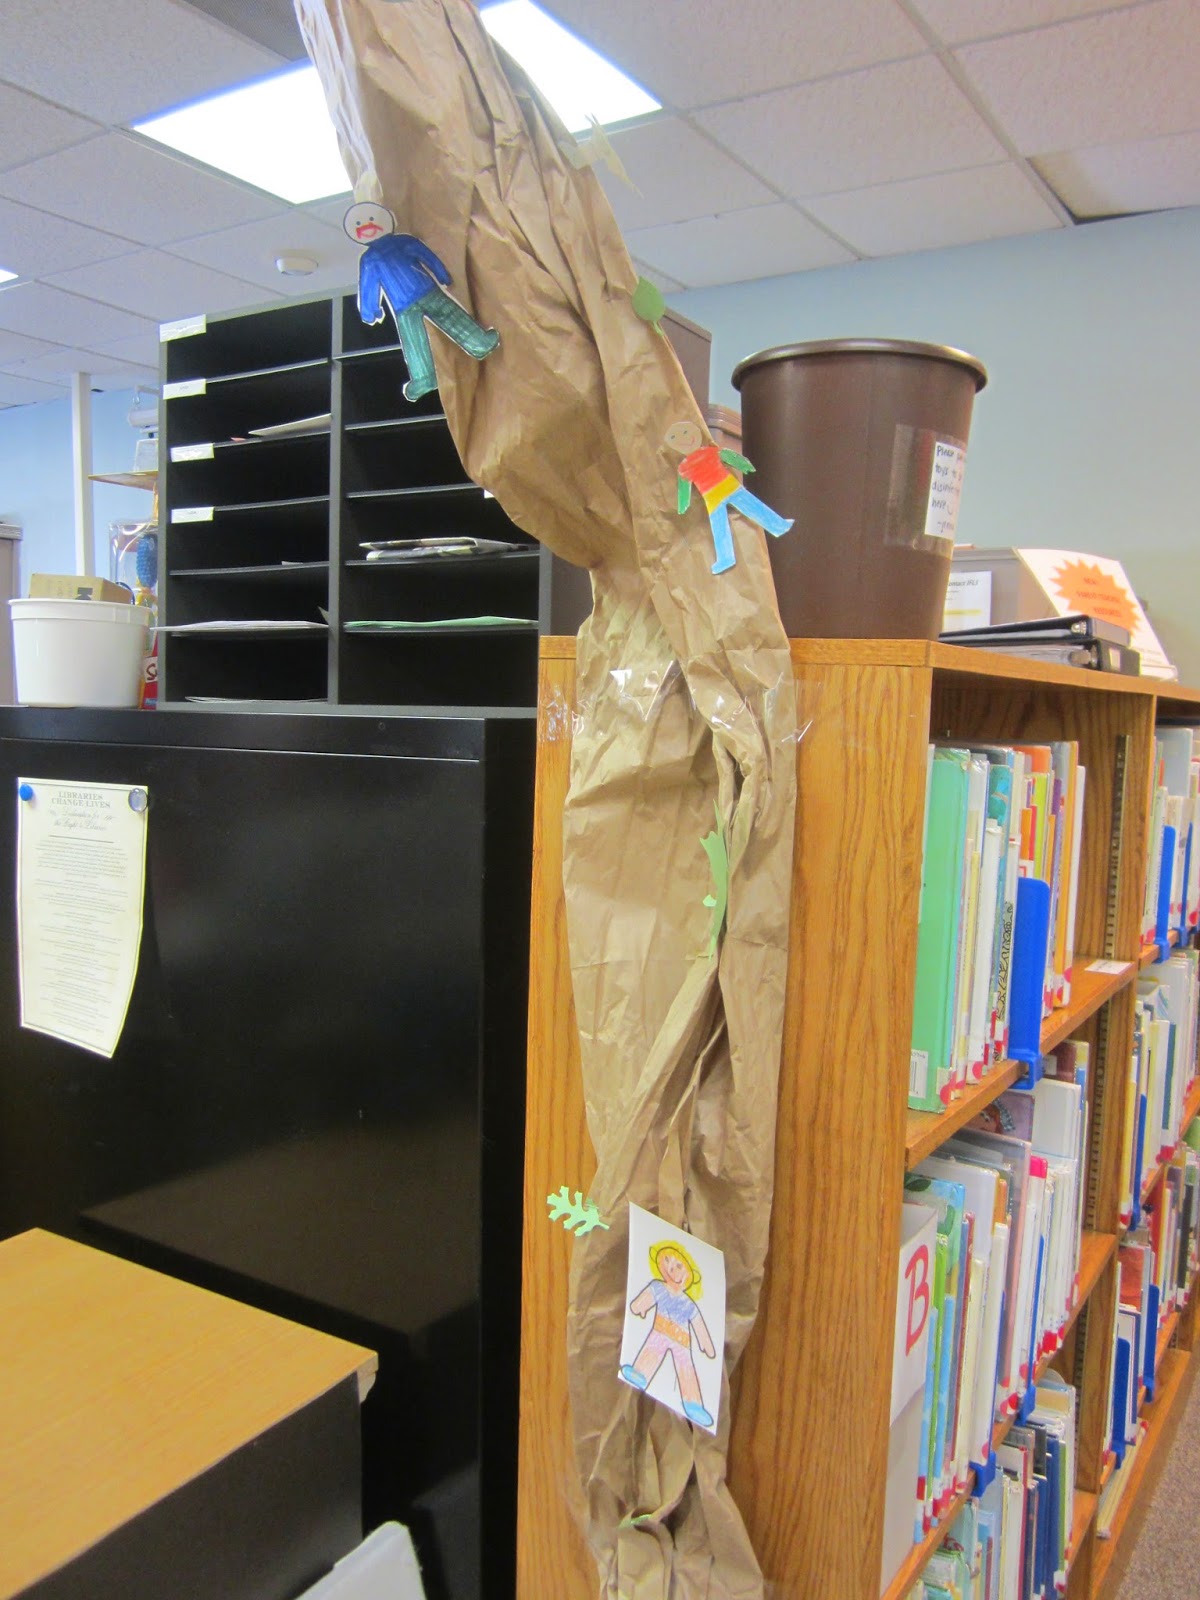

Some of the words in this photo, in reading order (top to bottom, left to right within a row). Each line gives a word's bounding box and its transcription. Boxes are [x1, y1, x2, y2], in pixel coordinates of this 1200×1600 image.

[58, 791, 103, 801] LIBRARIES
[51, 797, 85, 807] CHANGE
[86, 799, 111, 809] LIVES
[904, 1244, 930, 1356] B
